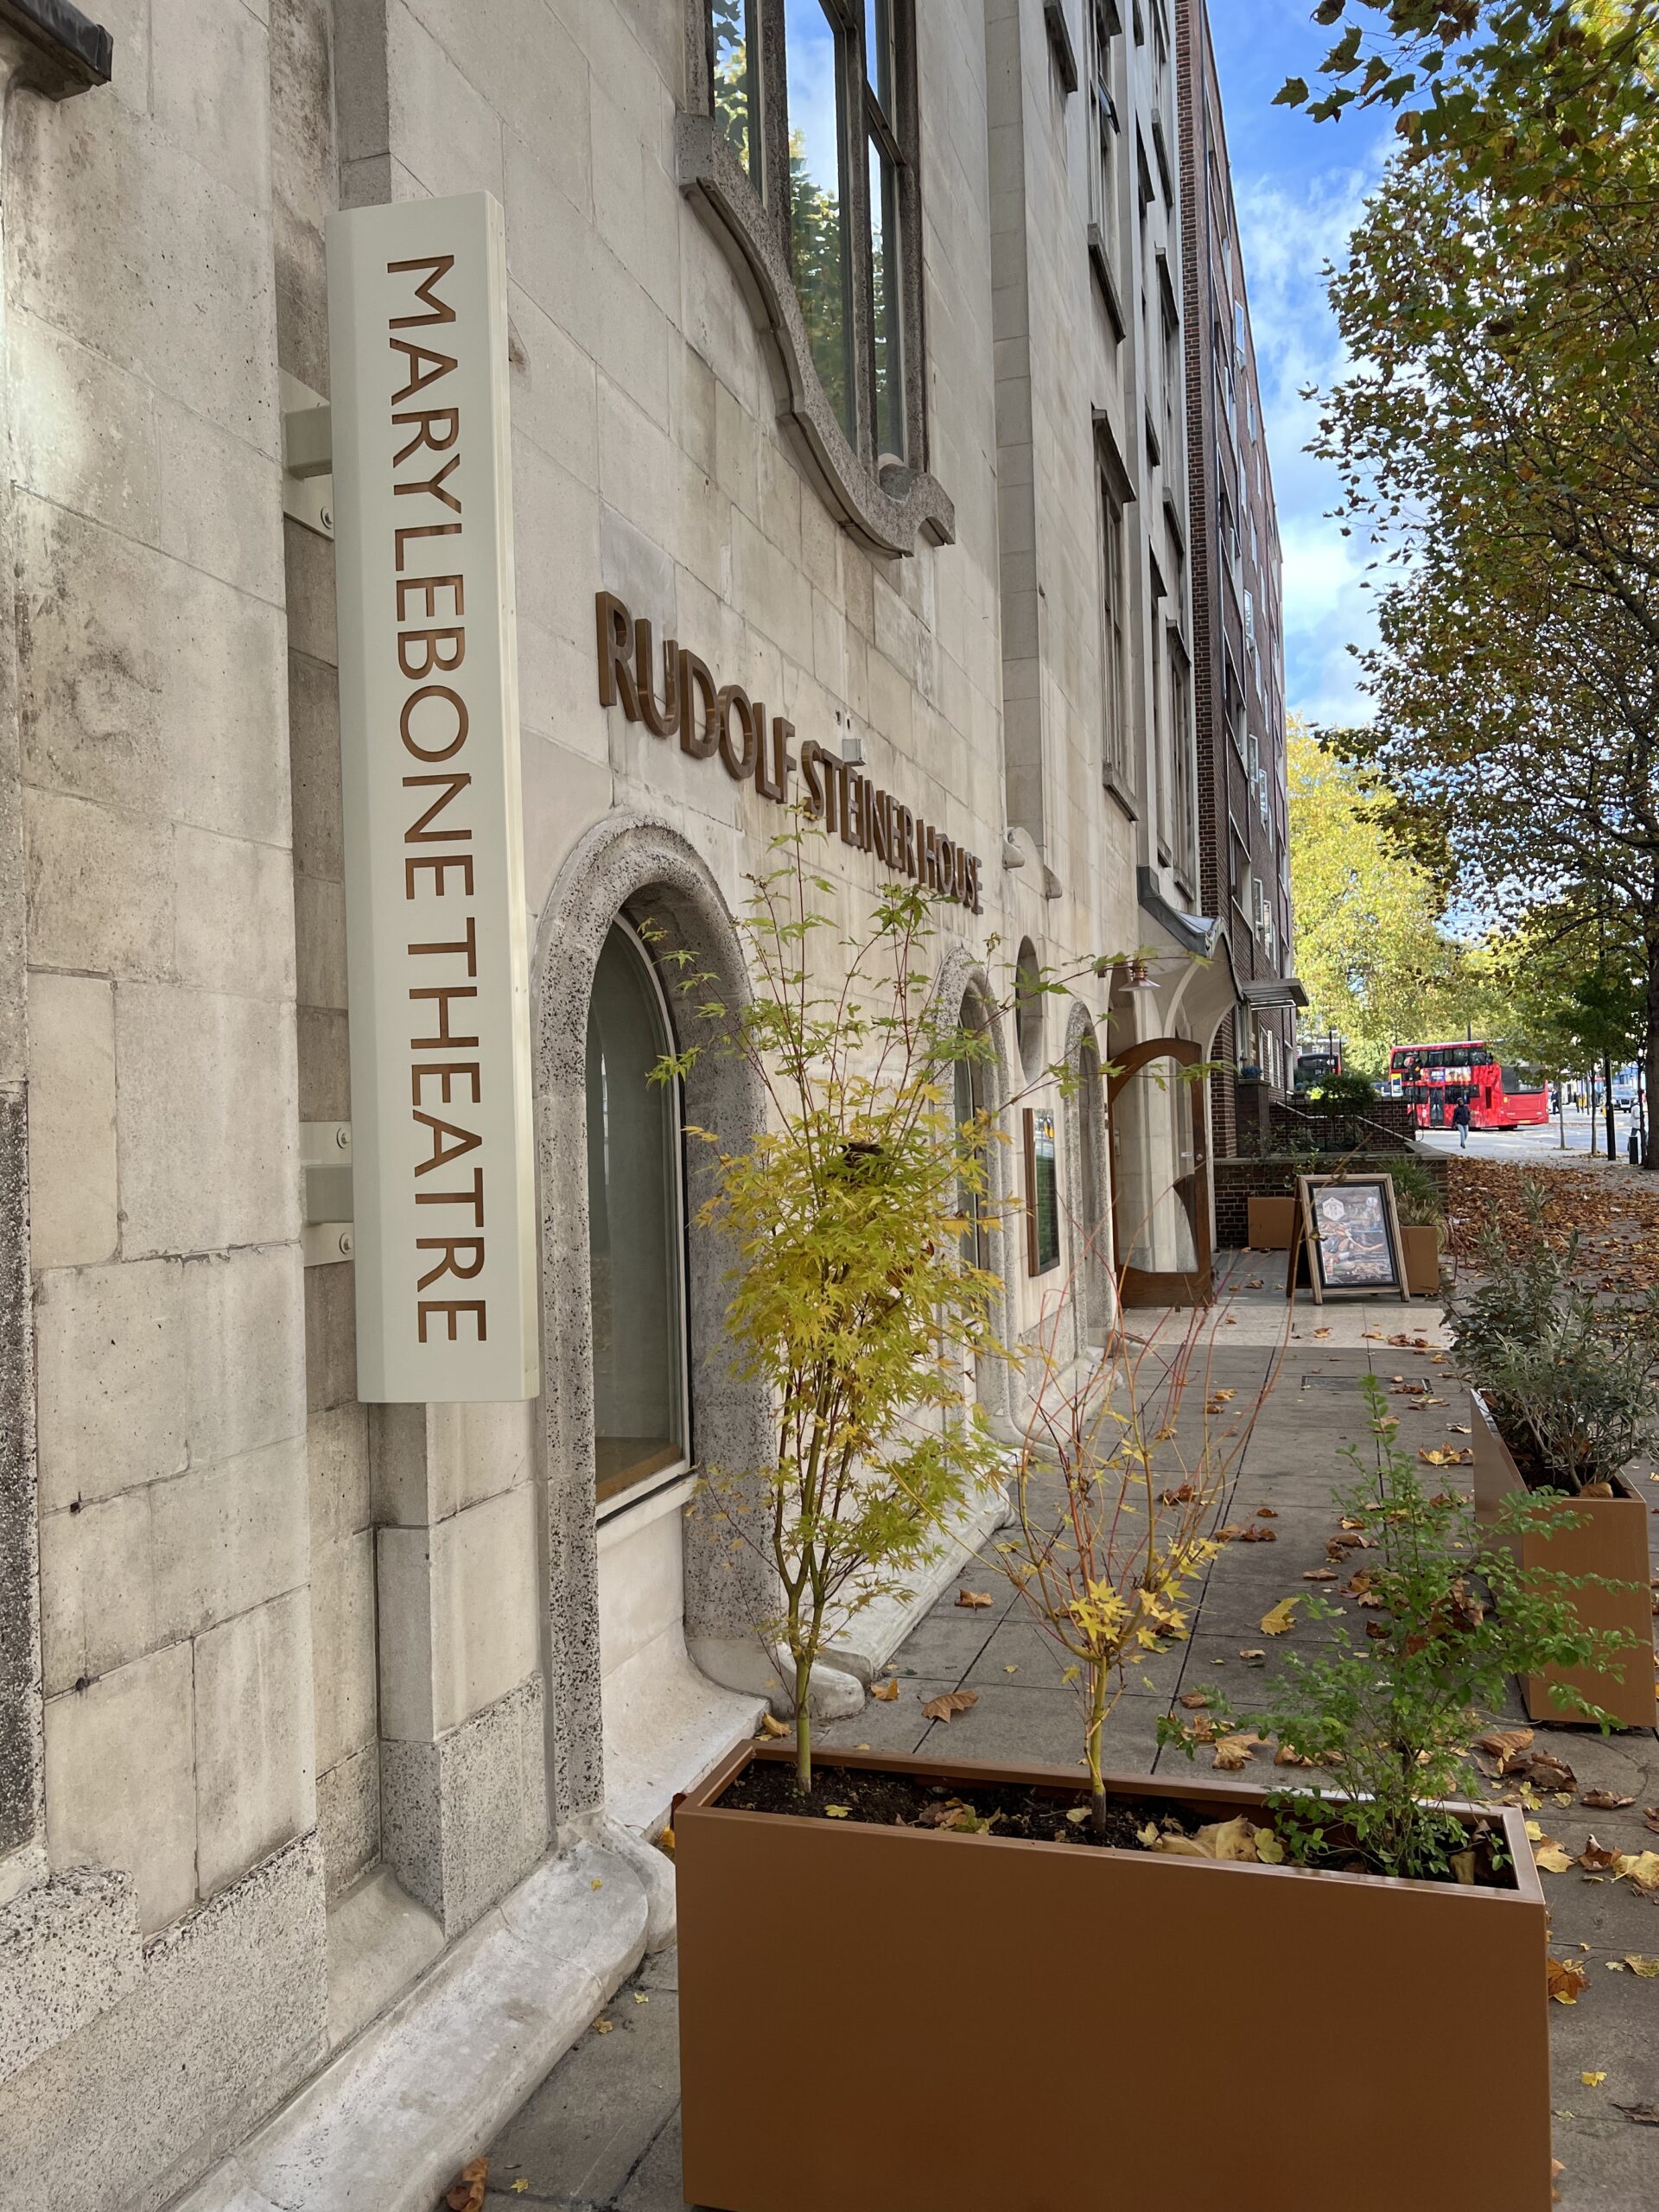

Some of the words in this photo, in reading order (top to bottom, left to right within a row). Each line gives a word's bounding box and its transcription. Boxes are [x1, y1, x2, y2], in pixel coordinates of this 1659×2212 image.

[387, 254, 475, 899] MARYLEBONE
[595, 591, 797, 804] RUDOLF
[801, 740, 918, 878] STEINER
[916, 819, 984, 915] HOUSE
[408, 917, 487, 1343] THEATRE
